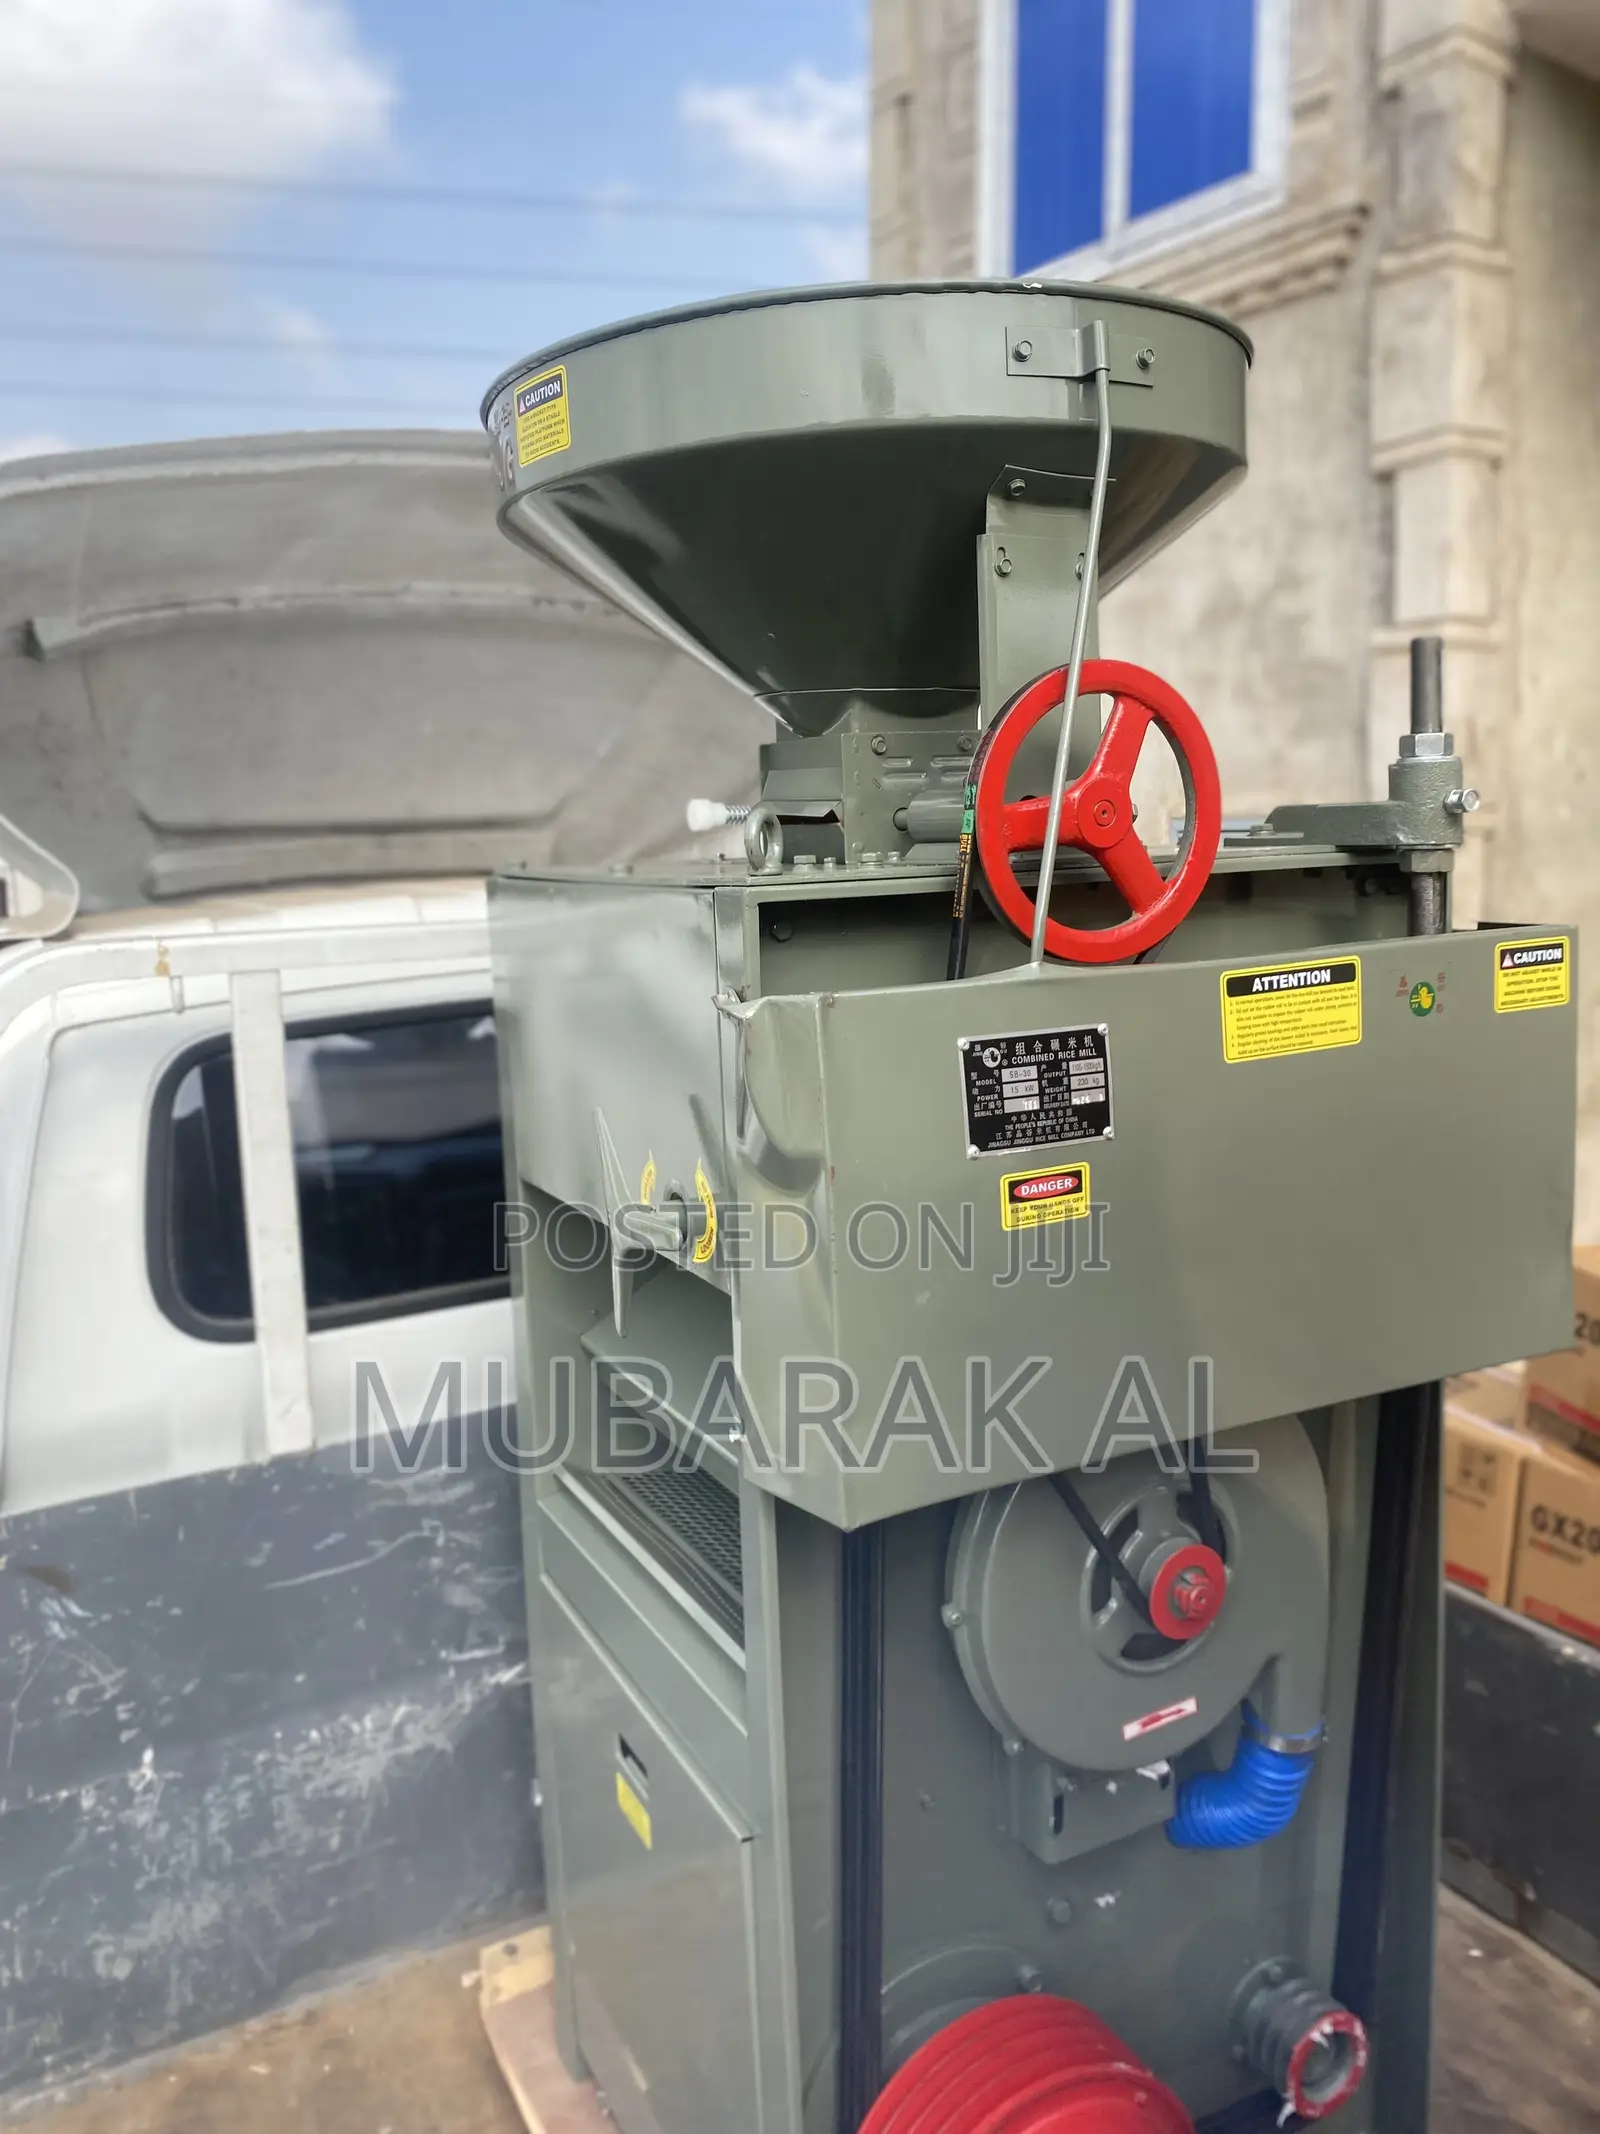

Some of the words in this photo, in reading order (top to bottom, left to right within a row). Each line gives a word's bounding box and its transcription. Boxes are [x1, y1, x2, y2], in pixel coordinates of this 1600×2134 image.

[525, 380, 560, 406] CAUTION
[1514, 948, 1563, 965] CAUTION
[1252, 968, 1331, 992] ATTENTION
[1011, 1053, 1055, 1065] COMBINED
[1058, 1050, 1076, 1060] RICE
[1079, 1048, 1097, 1057] MILL
[1009, 1069, 1032, 1079] SB-30
[1043, 1070, 1067, 1079] OUTPUT
[975, 1078, 997, 1086] MODEL
[1077, 1077, 1089, 1086] 230
[1092, 1076, 1100, 1086] kg
[1011, 1086, 1019, 1094] 15
[1045, 1086, 1067, 1094] WEIGHT
[977, 1094, 999, 1102] POWER
[974, 1110, 993, 1118] SERIAL
[1021, 1178, 1073, 1196] DANGER
